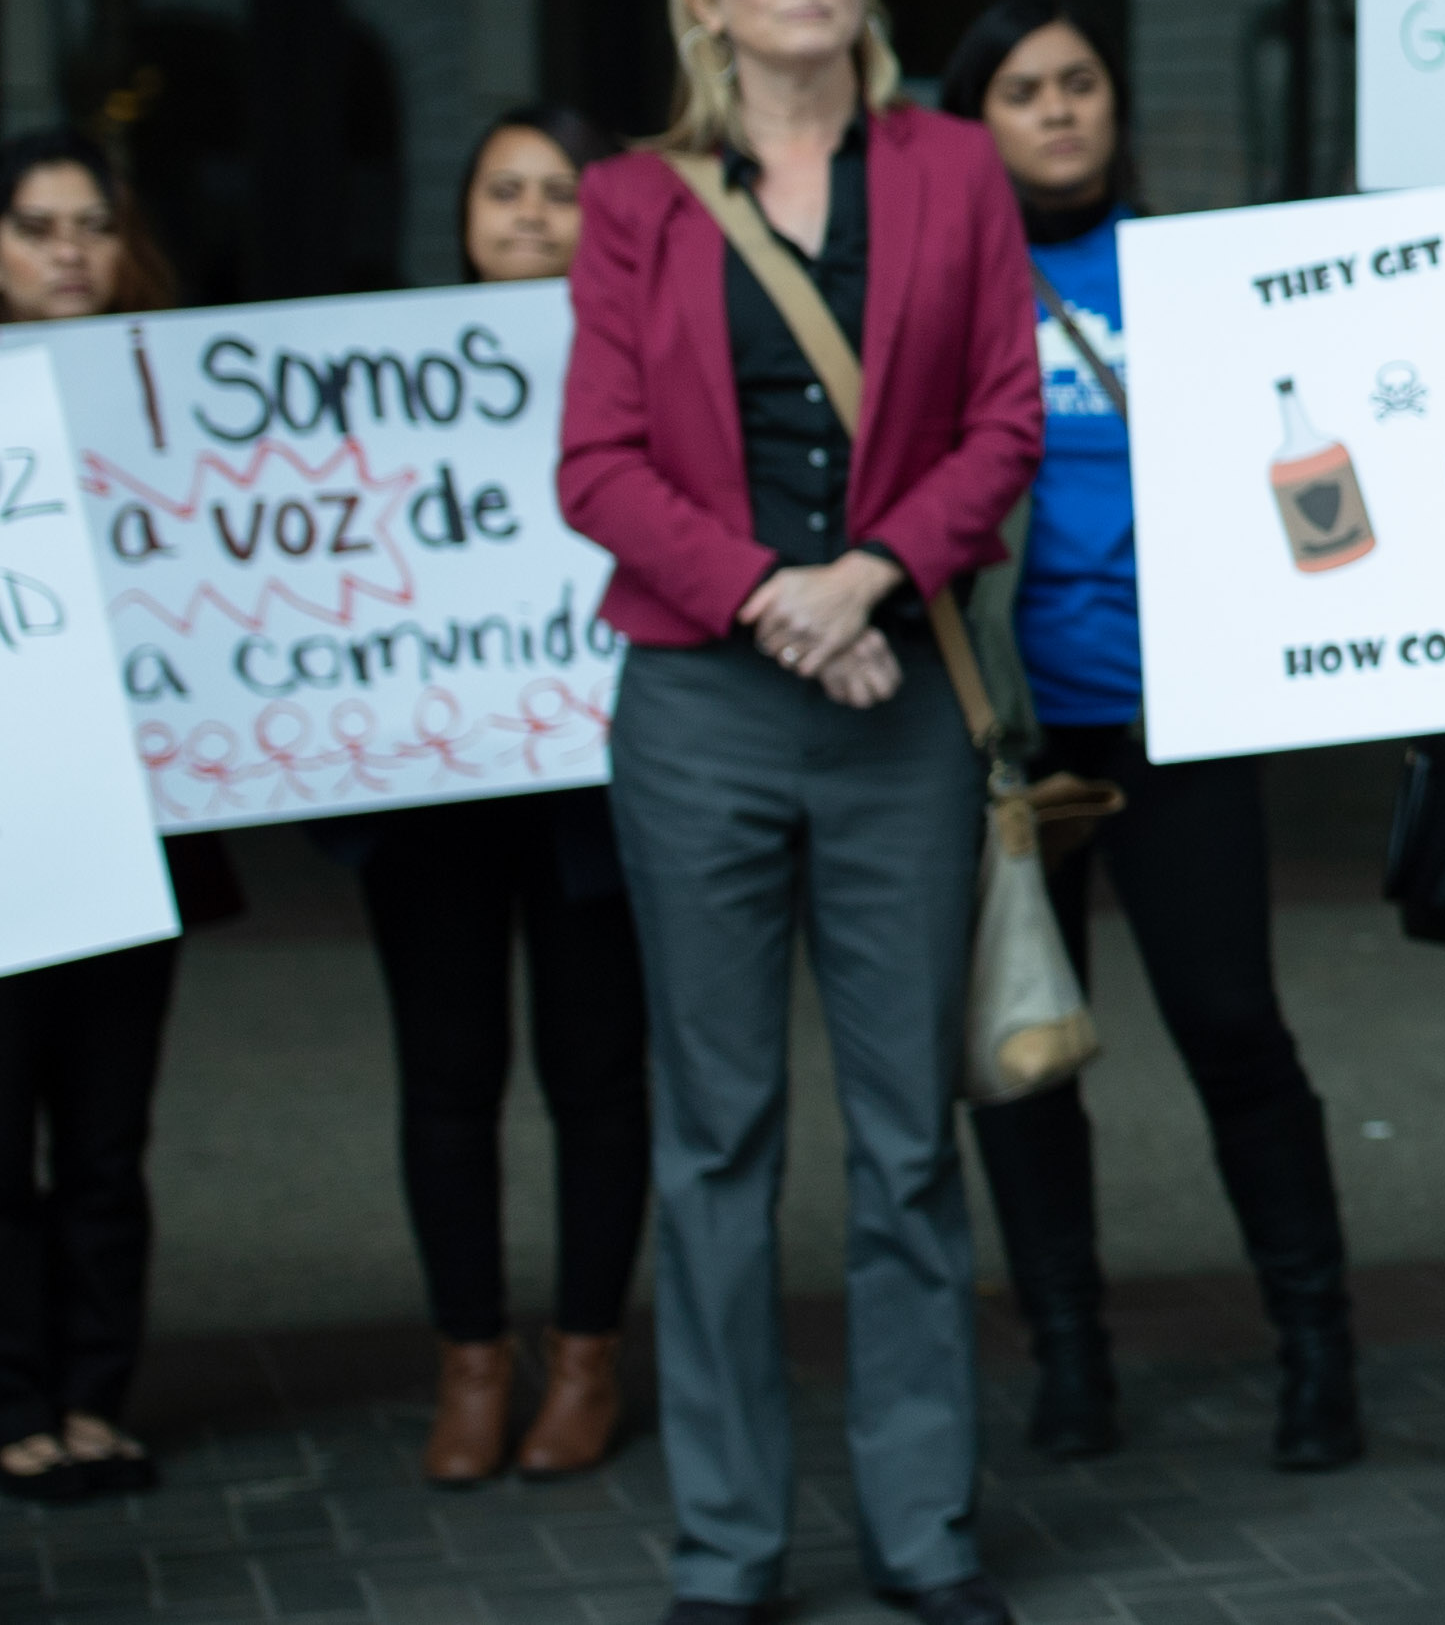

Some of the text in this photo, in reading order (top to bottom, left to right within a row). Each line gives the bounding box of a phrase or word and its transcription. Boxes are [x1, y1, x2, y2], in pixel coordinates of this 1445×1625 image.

[1252, 236, 1444, 307] THEY GET
[211, 490, 377, 563] voz
[409, 459, 523, 551] de
[1284, 639, 1384, 679] HOW
